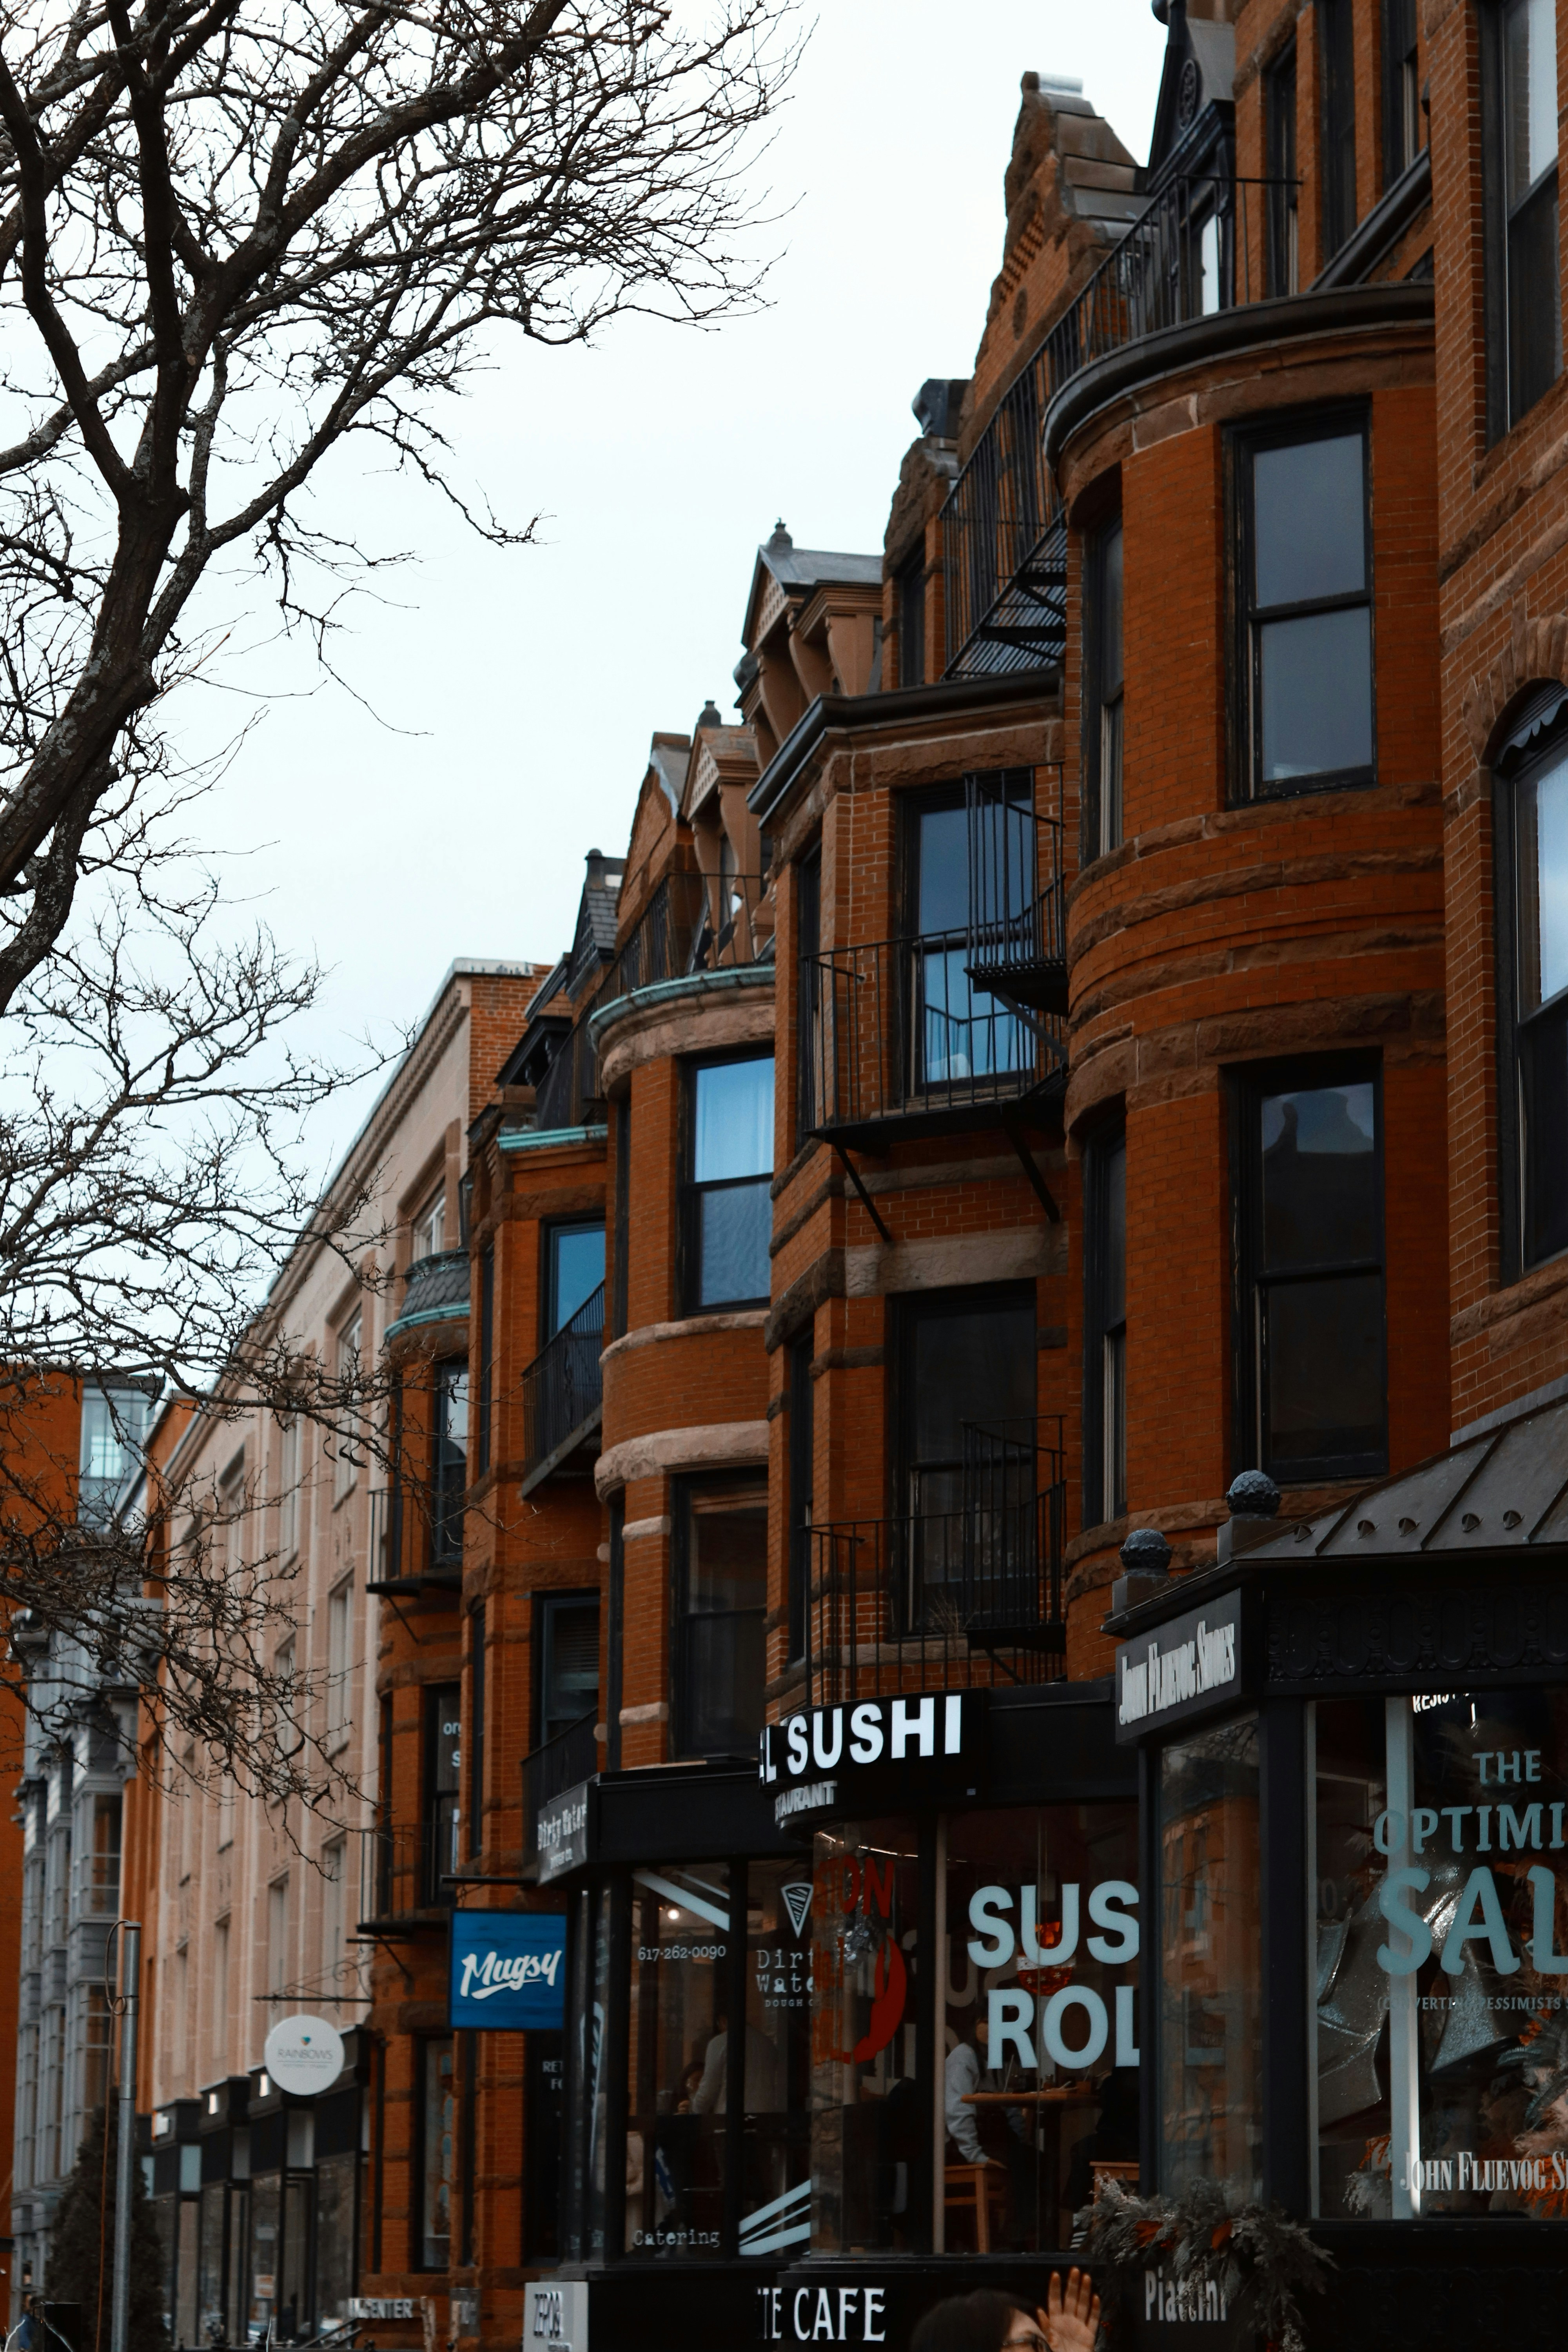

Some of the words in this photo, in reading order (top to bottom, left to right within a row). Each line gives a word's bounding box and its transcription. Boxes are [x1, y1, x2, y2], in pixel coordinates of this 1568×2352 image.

[787, 1695, 961, 1775] SUSHI
[1472, 1750, 1541, 1785] THE
[1373, 1802, 1565, 1855] OPTIMI
[967, 1880, 1140, 1968] SUS
[1376, 1865, 1568, 1976] SAL
[460, 1950, 562, 1999] Mugsy
[765, 1999, 803, 2007] DOUGH
[987, 1985, 1140, 2069] ROL
[1400, 2151, 1453, 2191] JOHN
[1457, 2151, 1546, 2191] FLUEVOG
[1551, 2150, 1568, 2191] S
[634, 2229, 720, 2248] Catering
[793, 2287, 886, 2342] CAFE
